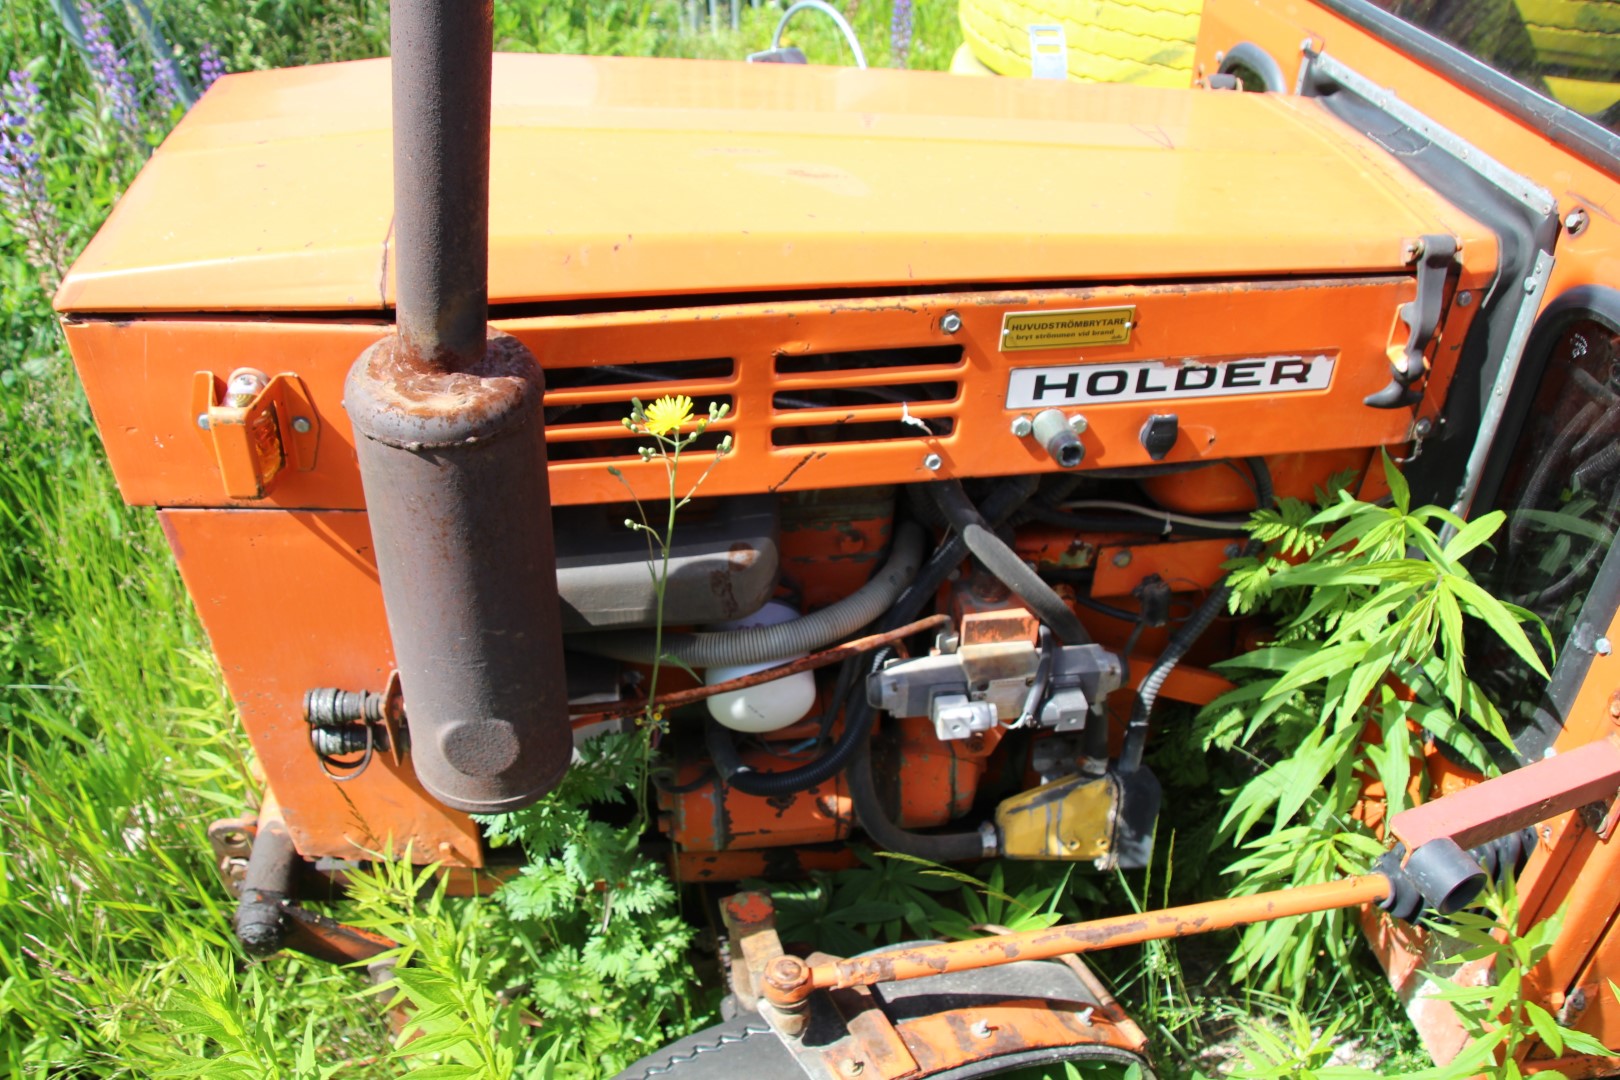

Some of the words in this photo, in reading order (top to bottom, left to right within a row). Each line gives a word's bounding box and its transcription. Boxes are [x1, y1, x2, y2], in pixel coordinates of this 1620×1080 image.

[1012, 318, 1125, 331] HUVUDSTRÖMBRYTARE
[1035, 331, 1075, 340] strömmen
[1078, 329, 1090, 337] vid
[1092, 328, 1114, 336] brand
[1032, 360, 1312, 400] HOLDER
